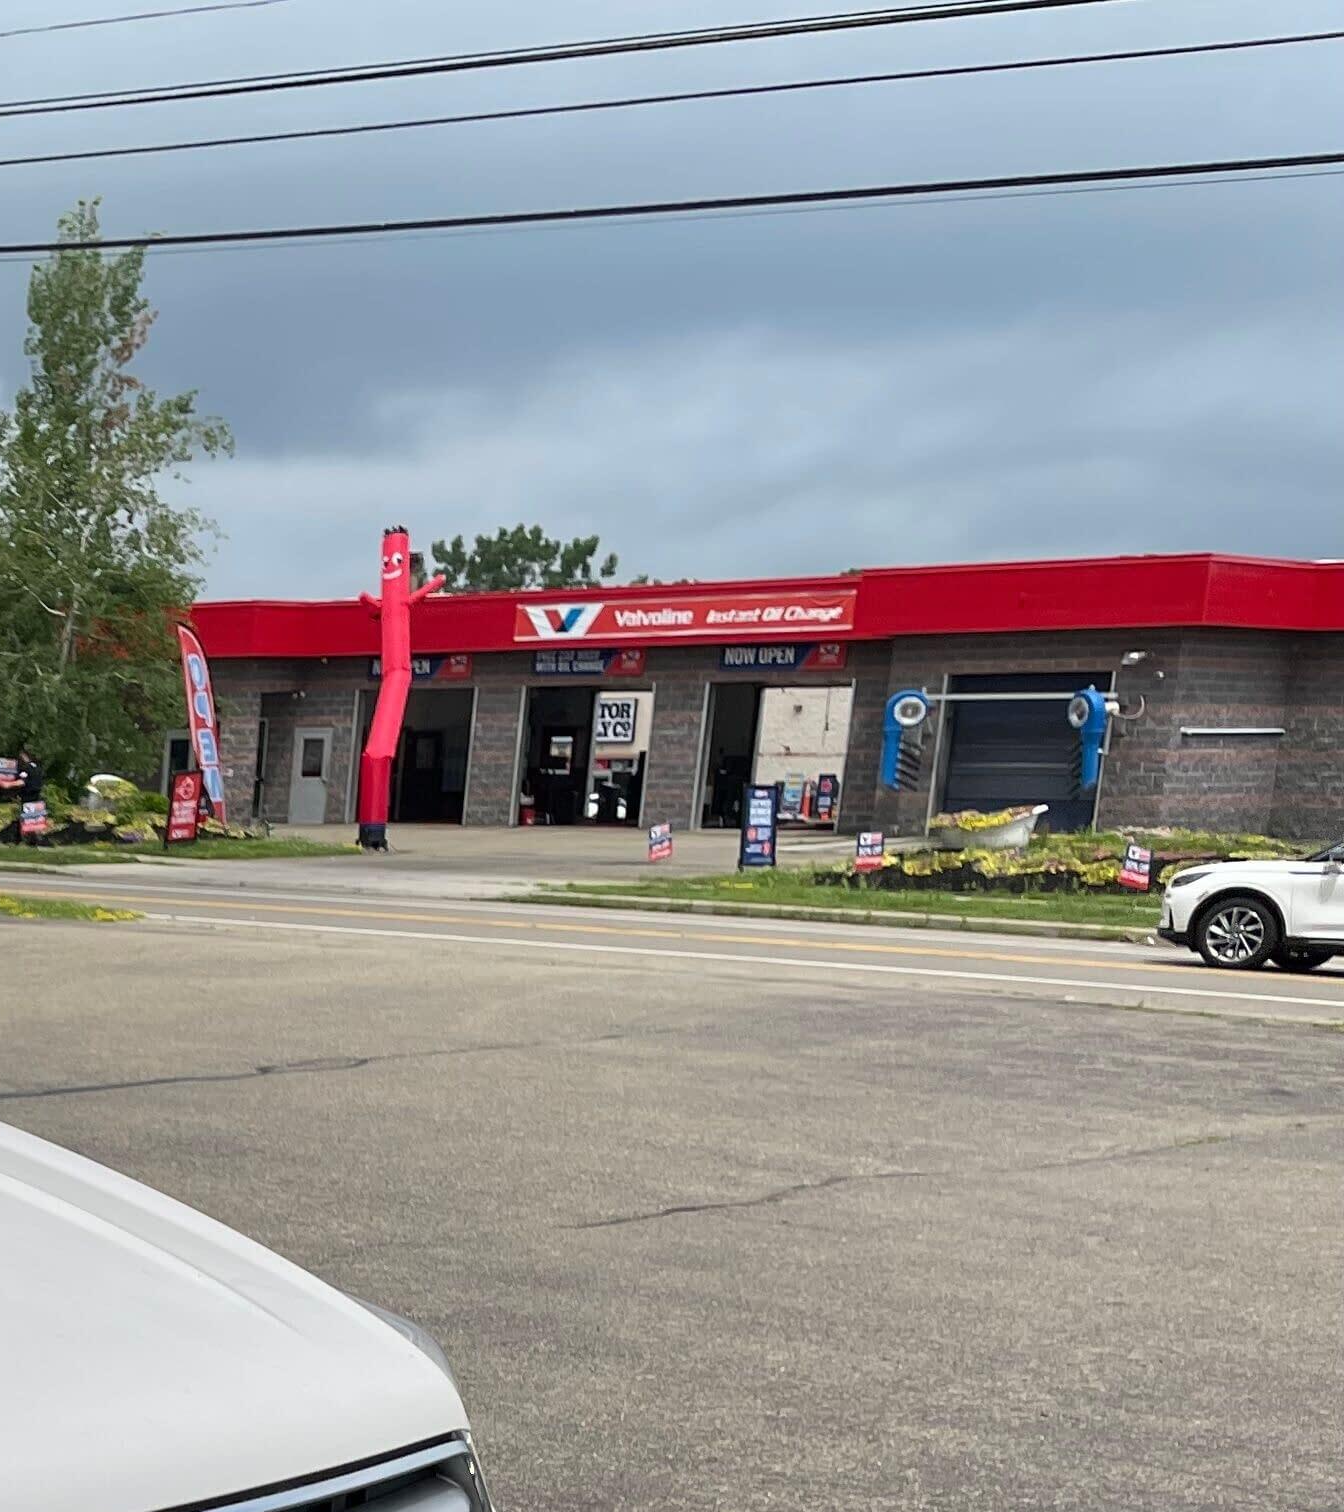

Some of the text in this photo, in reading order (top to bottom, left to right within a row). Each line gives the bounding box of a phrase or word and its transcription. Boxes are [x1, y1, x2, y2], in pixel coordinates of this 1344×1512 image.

[614, 606, 844, 627] Valvoline Instant Oil Change
[725, 646, 795, 665] NOW OPEN
[186, 652, 224, 802] OPEN
